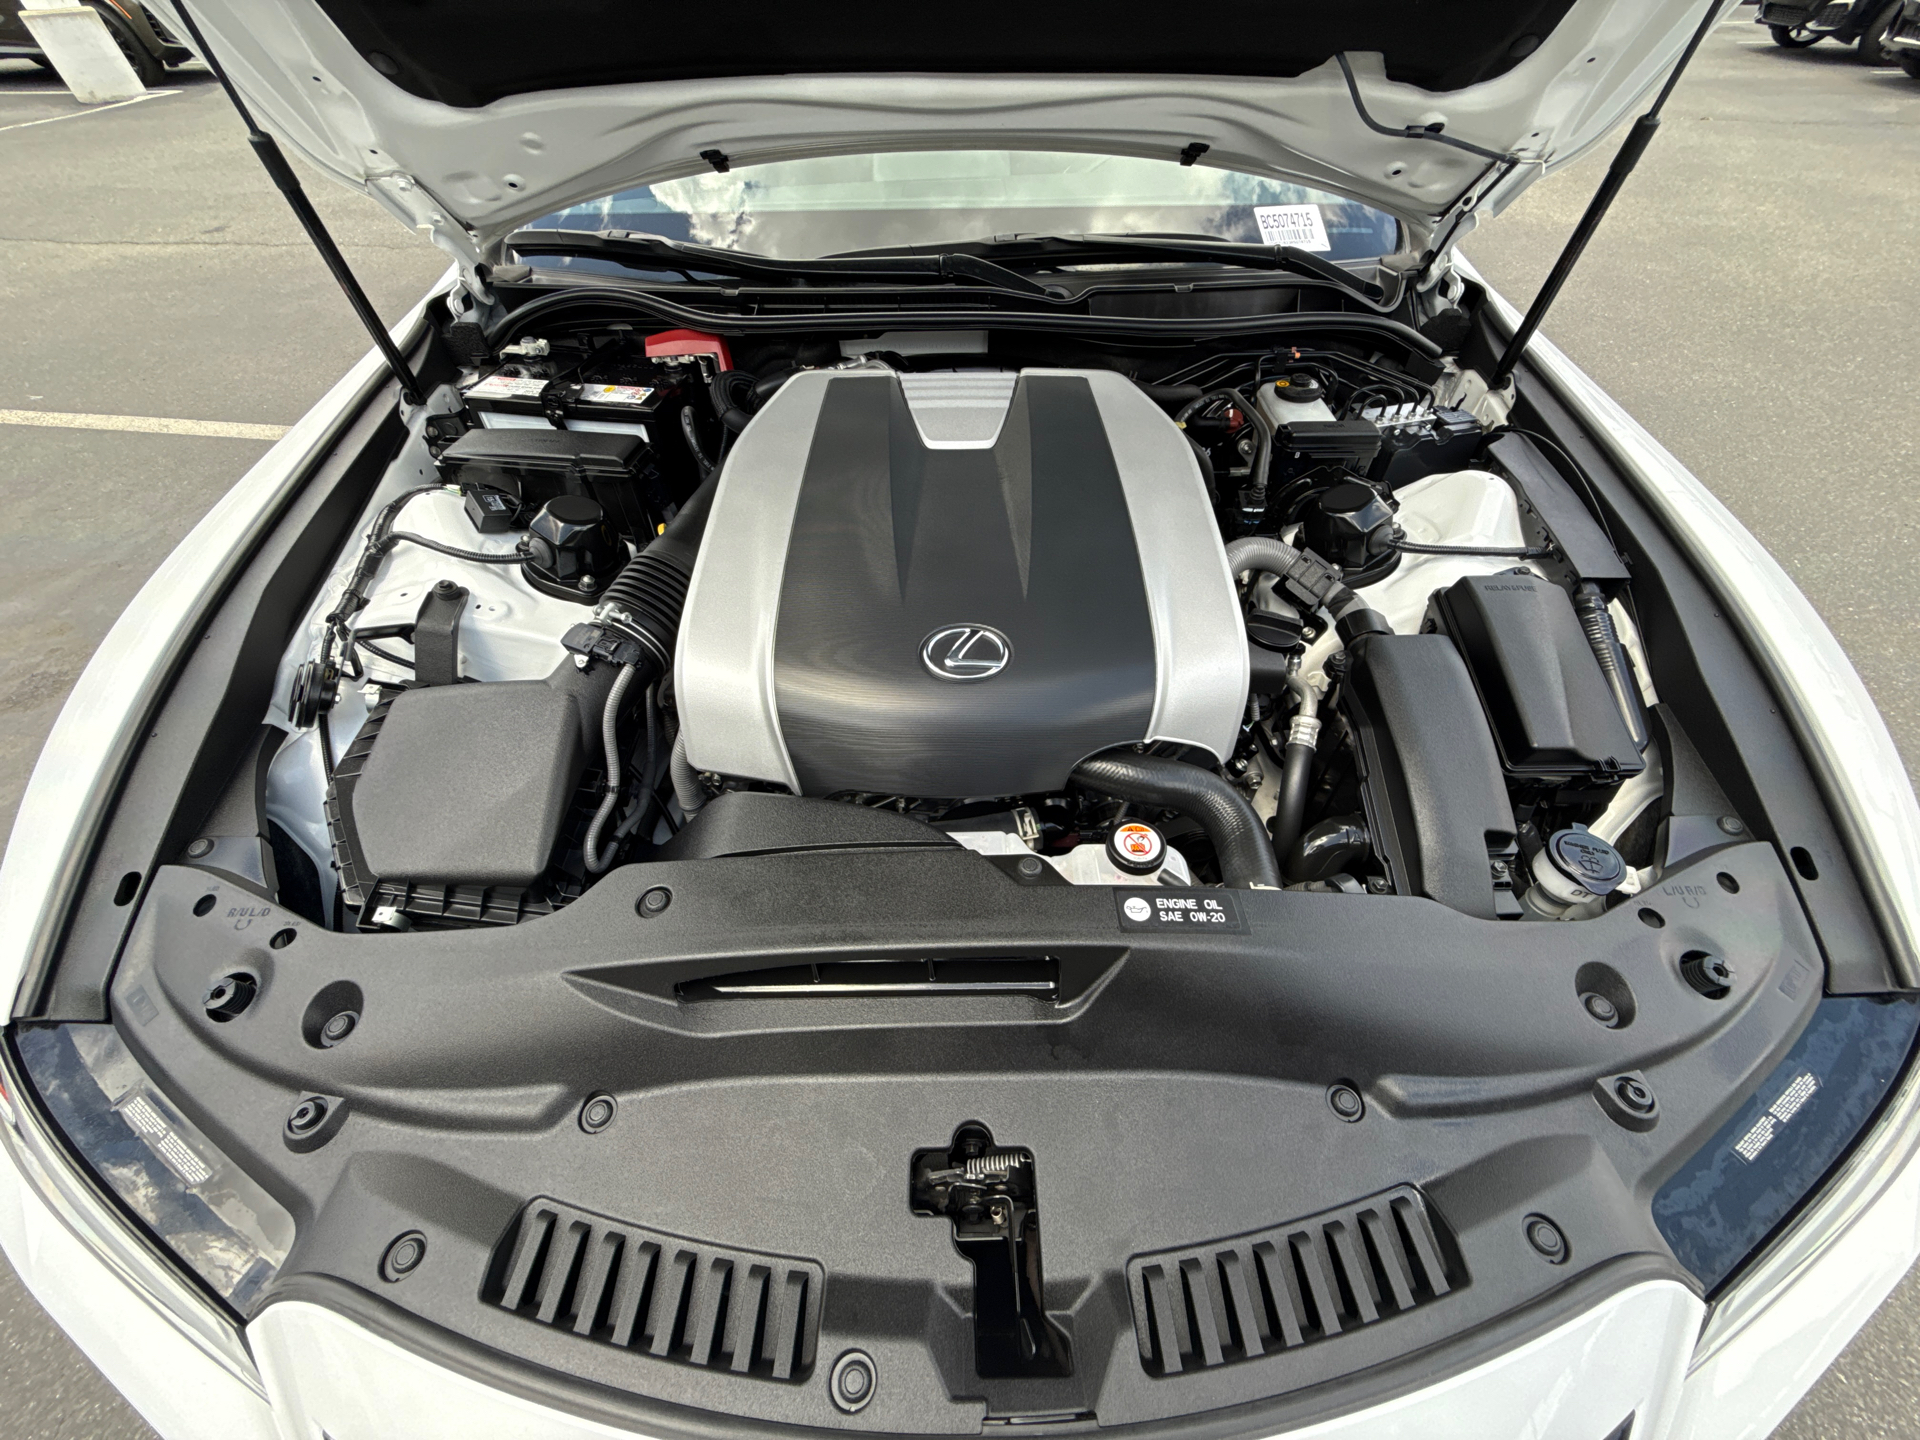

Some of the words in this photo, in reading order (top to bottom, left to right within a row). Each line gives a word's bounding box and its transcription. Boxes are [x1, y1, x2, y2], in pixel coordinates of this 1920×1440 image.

[1260, 212, 1313, 229] BC5074715
[1155, 898, 1198, 910] ENGINE
[1203, 899, 1223, 910] OIL
[1159, 911, 1184, 922] SAE
